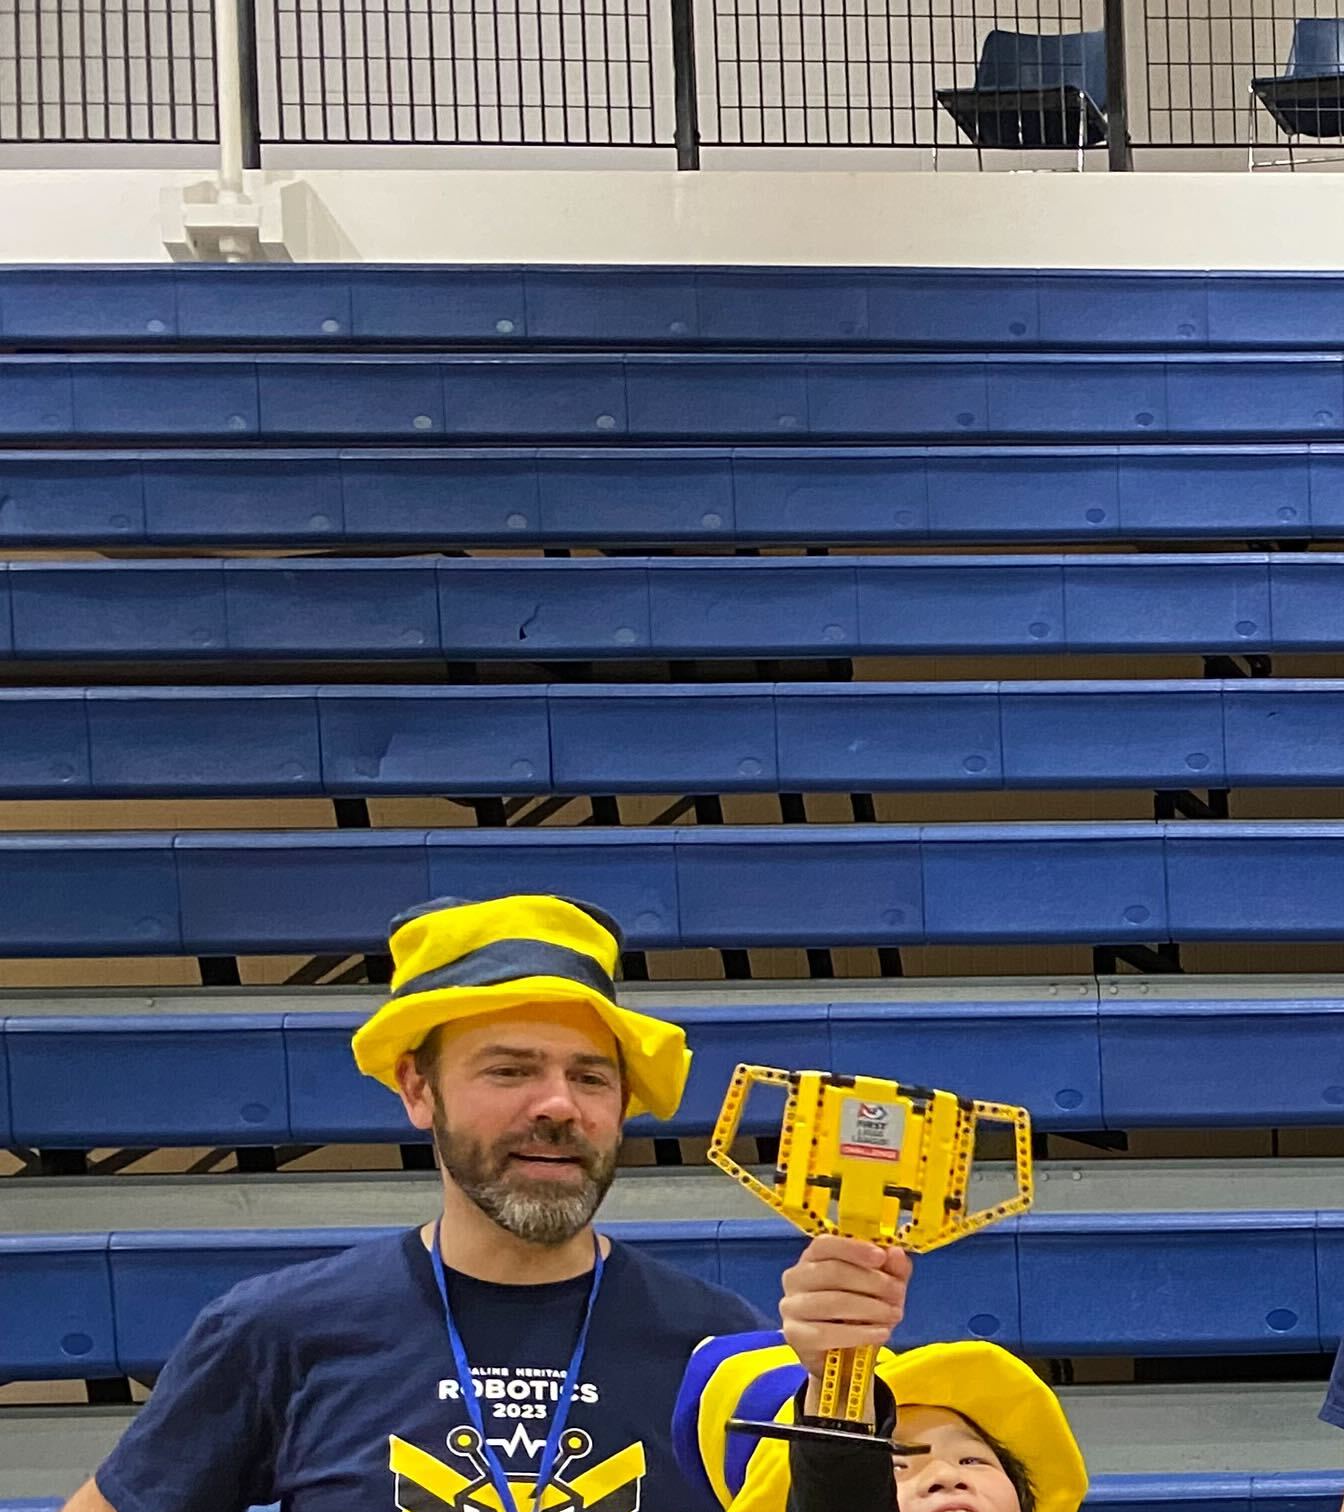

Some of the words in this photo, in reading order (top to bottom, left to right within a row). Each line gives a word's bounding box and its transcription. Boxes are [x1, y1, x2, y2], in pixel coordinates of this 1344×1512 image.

[469, 1367, 509, 1376] ALINE
[515, 1367, 568, 1378] HERITAG
[492, 1402, 547, 1419] 2023
